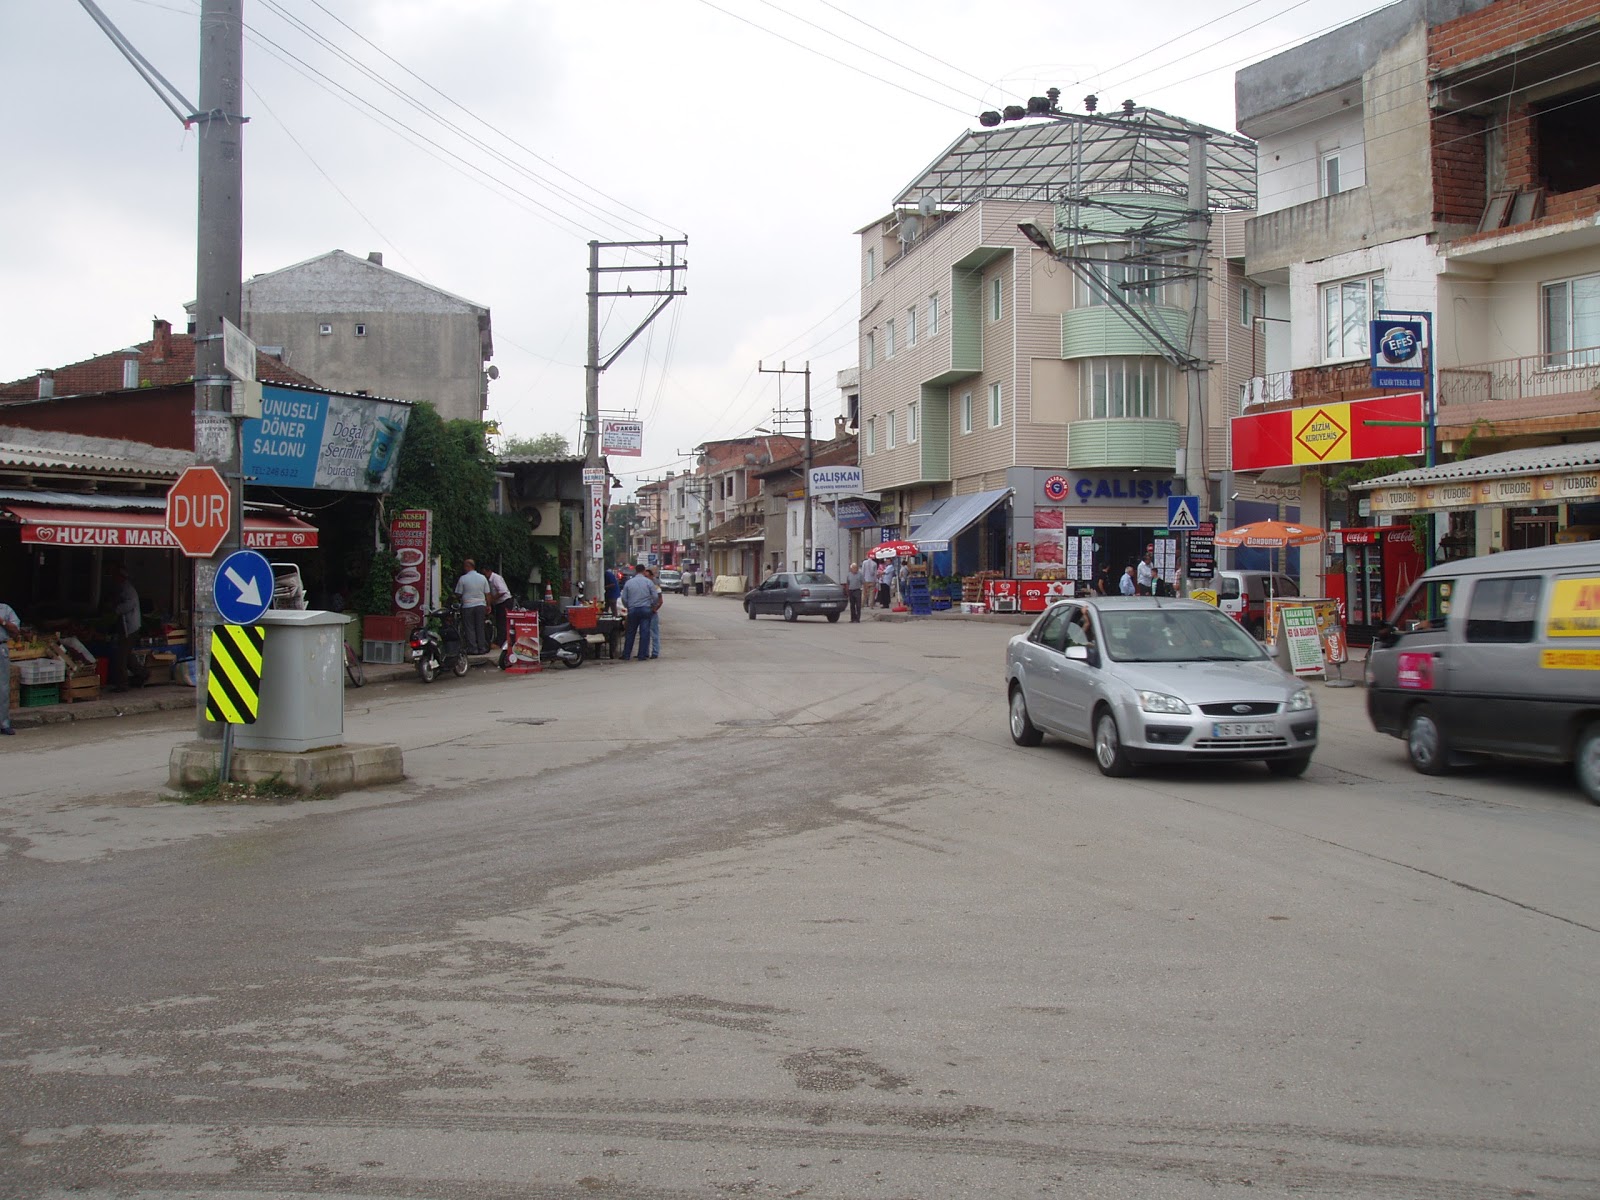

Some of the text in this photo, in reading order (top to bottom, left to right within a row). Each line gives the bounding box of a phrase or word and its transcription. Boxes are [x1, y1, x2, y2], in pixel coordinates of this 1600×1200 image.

[1388, 335, 1413, 351] EFES
[262, 399, 319, 421] UNUSELİ
[261, 417, 306, 438] DÖNER
[332, 421, 367, 442] Doğal
[1311, 422, 1331, 432] BİZİM
[252, 438, 306, 458] SALONU
[324, 442, 366, 460] Serinlik
[327, 464, 357, 477] burada
[813, 471, 860, 484] ÇALIŞKAN
[1045, 474, 1069, 489] ÇALIŞKAN
[1500, 482, 1531, 495] TUBORG
[1563, 476, 1598, 490] TUBORG
[1390, 491, 1417, 504] TUBORG
[1443, 487, 1471, 500] TUBORG
[174, 494, 224, 528] DUR
[594, 497, 602, 553] KASAP
[56, 527, 179, 546] HUZUR MARK
[1247, 537, 1283, 546] DONDURMA
[1346, 532, 1368, 542] Coca-Cola
[1387, 530, 1414, 543] Coca-Cola
[1300, 618, 1315, 626] TUR
